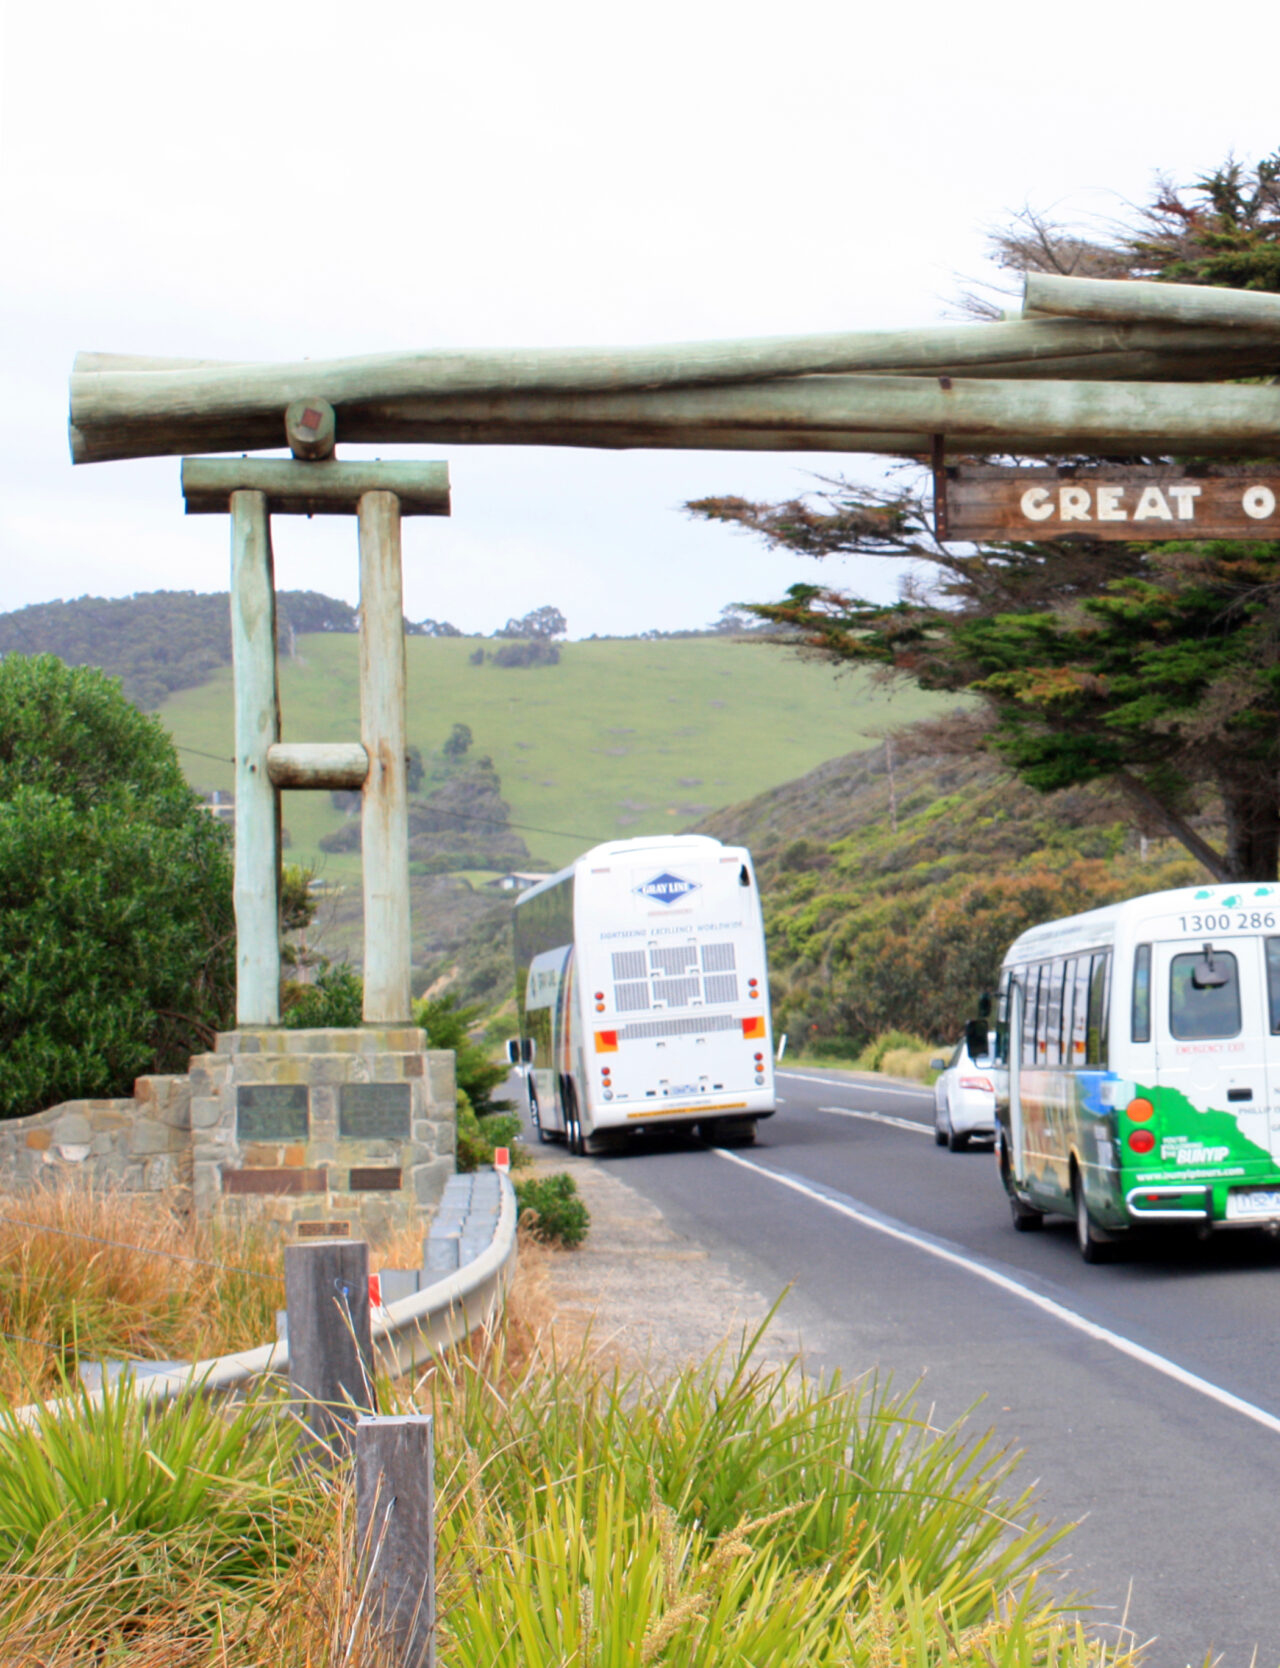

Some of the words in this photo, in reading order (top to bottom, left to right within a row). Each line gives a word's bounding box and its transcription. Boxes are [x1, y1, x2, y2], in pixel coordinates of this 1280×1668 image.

[1020, 486, 1202, 521] GREAT
[642, 883, 667, 895] GRAY
[667, 882, 689, 893] LINE
[1179, 914, 1230, 932] 1300
[1237, 912, 1276, 929] 286
[1238, 1106, 1271, 1114] PHILLIP
[1177, 1146, 1229, 1164] BUNYIP
